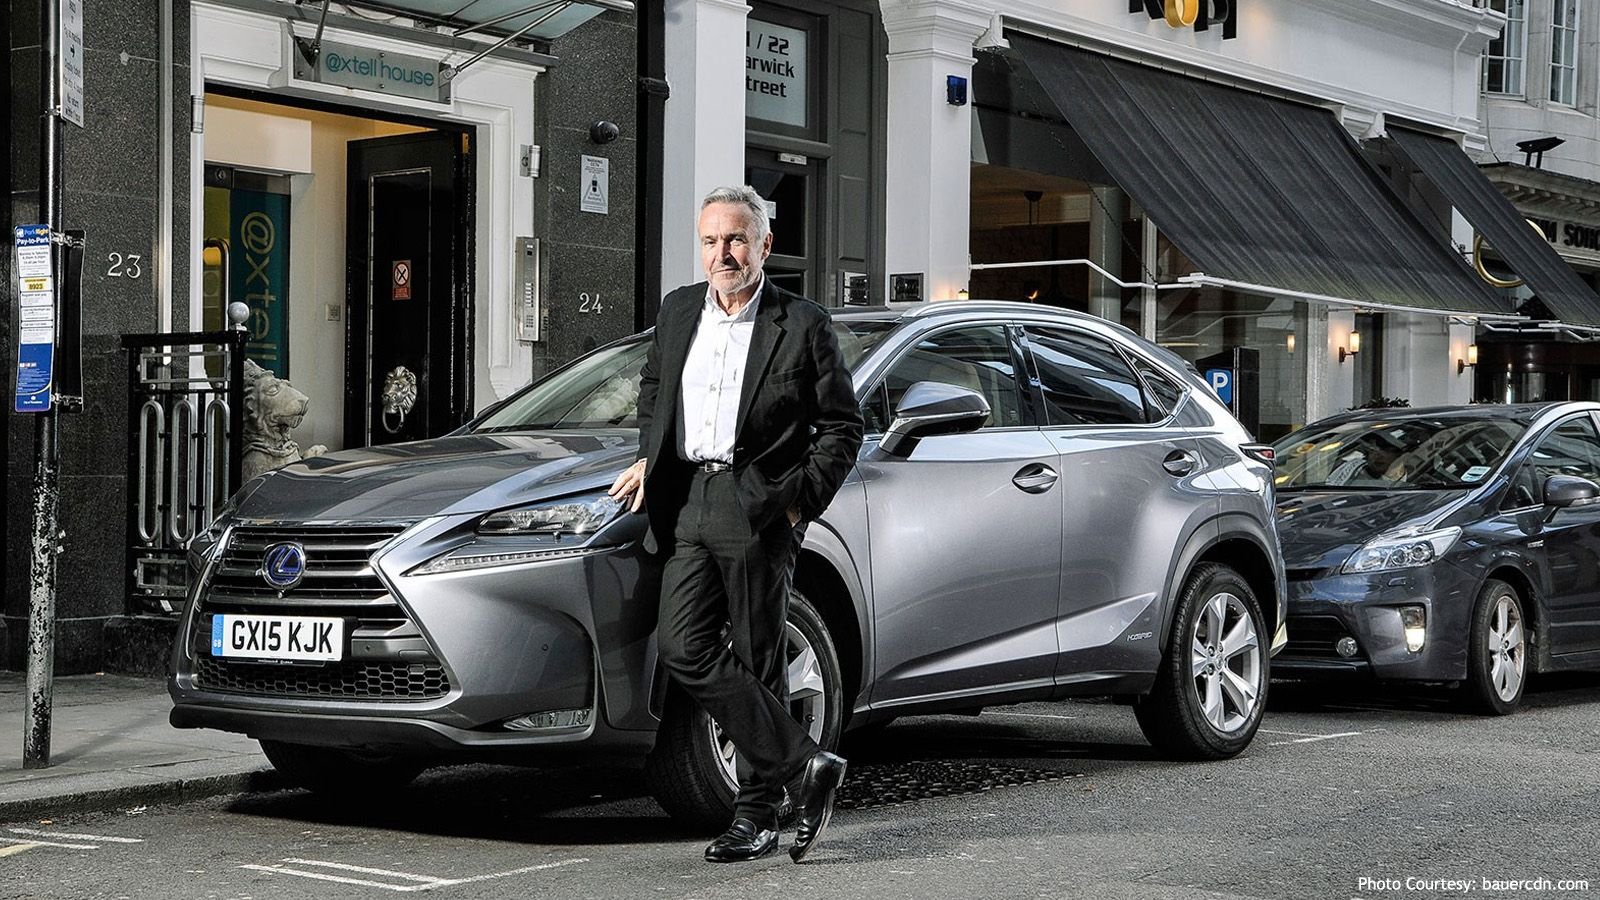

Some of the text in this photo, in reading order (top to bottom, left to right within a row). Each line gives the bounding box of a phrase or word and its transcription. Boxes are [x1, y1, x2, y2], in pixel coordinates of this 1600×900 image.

[768, 35, 789, 56] 22
[325, 52, 435, 87] @xtell house
[746, 56, 795, 78] arwick
[746, 75, 787, 98] treet
[107, 252, 141, 279] 23
[578, 292, 603, 314] 24
[1213, 372, 1229, 393] P
[232, 620, 333, 654] GX15 KJK
